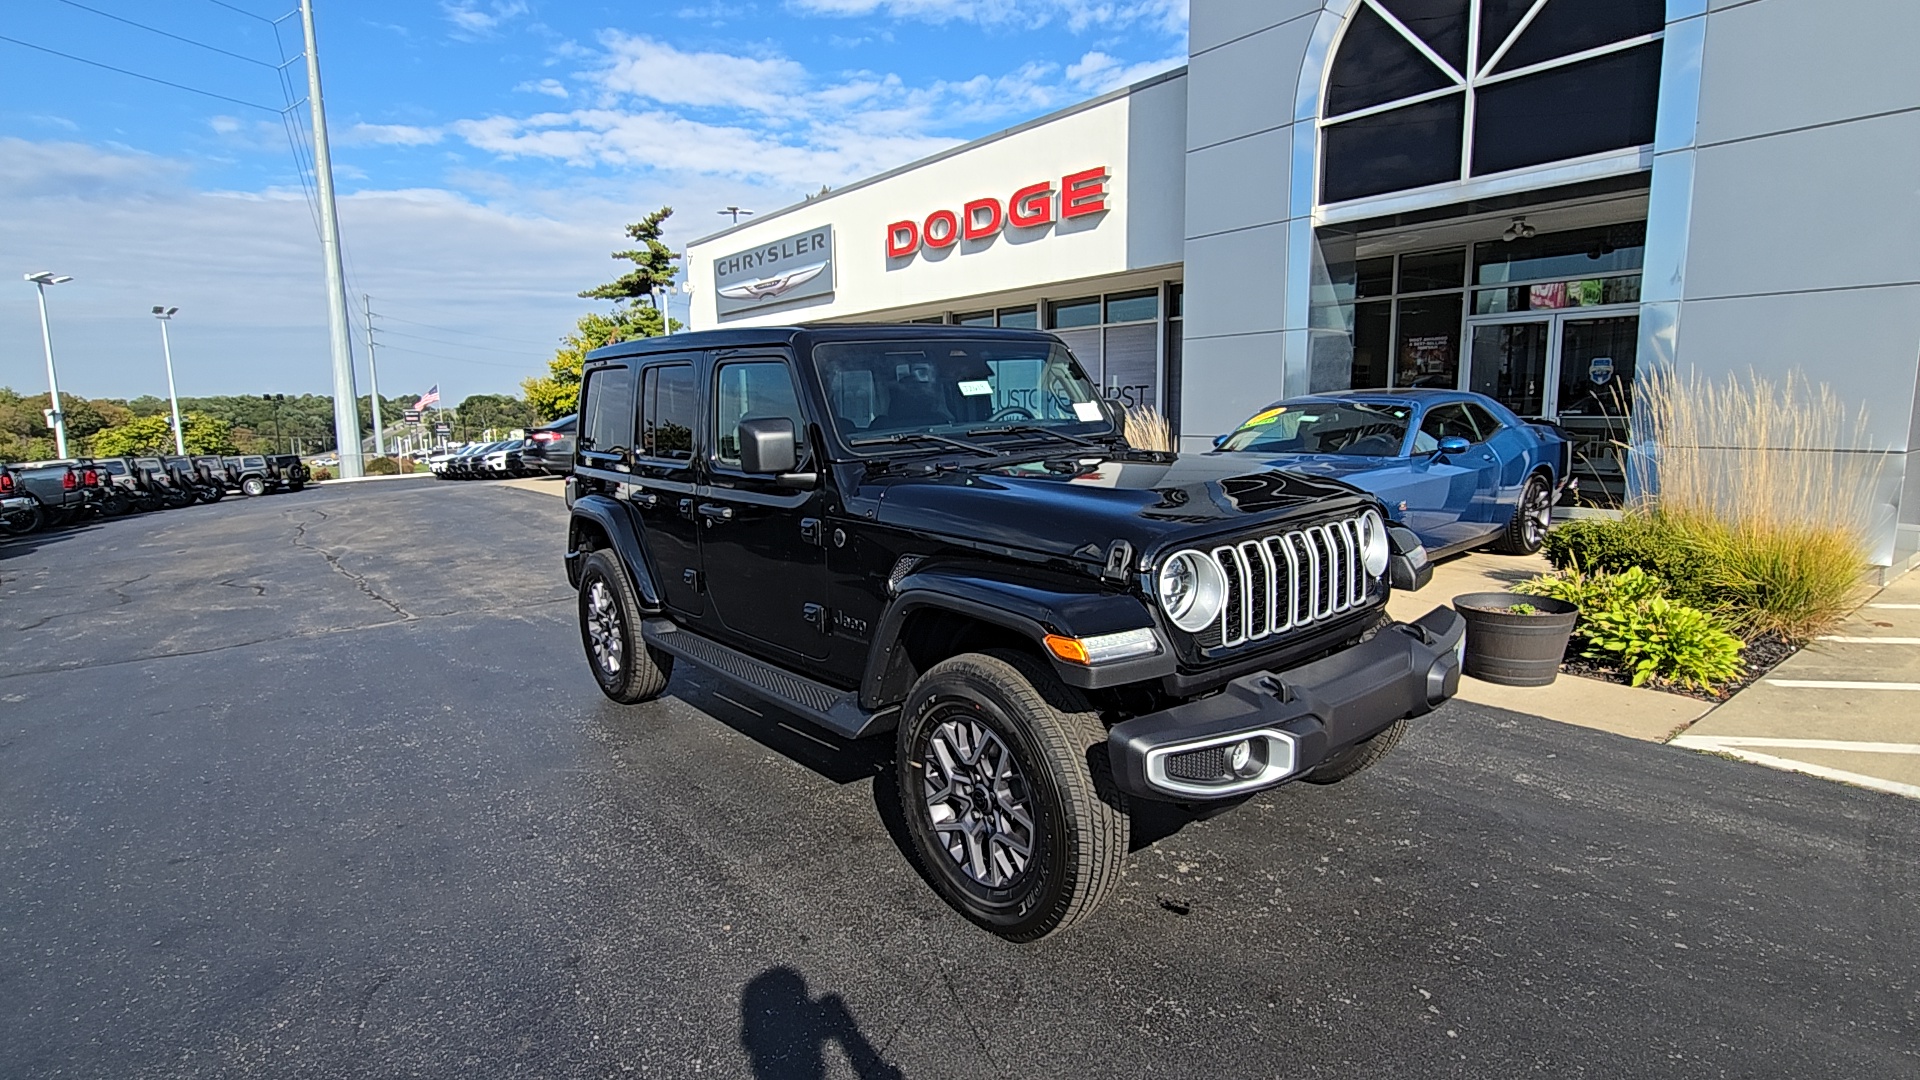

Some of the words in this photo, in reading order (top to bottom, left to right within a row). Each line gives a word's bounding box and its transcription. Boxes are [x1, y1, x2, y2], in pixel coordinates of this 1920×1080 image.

[887, 166, 1110, 258] DODGE
[717, 233, 825, 276] CHRYSLER
[833, 609, 867, 636] Jeep
